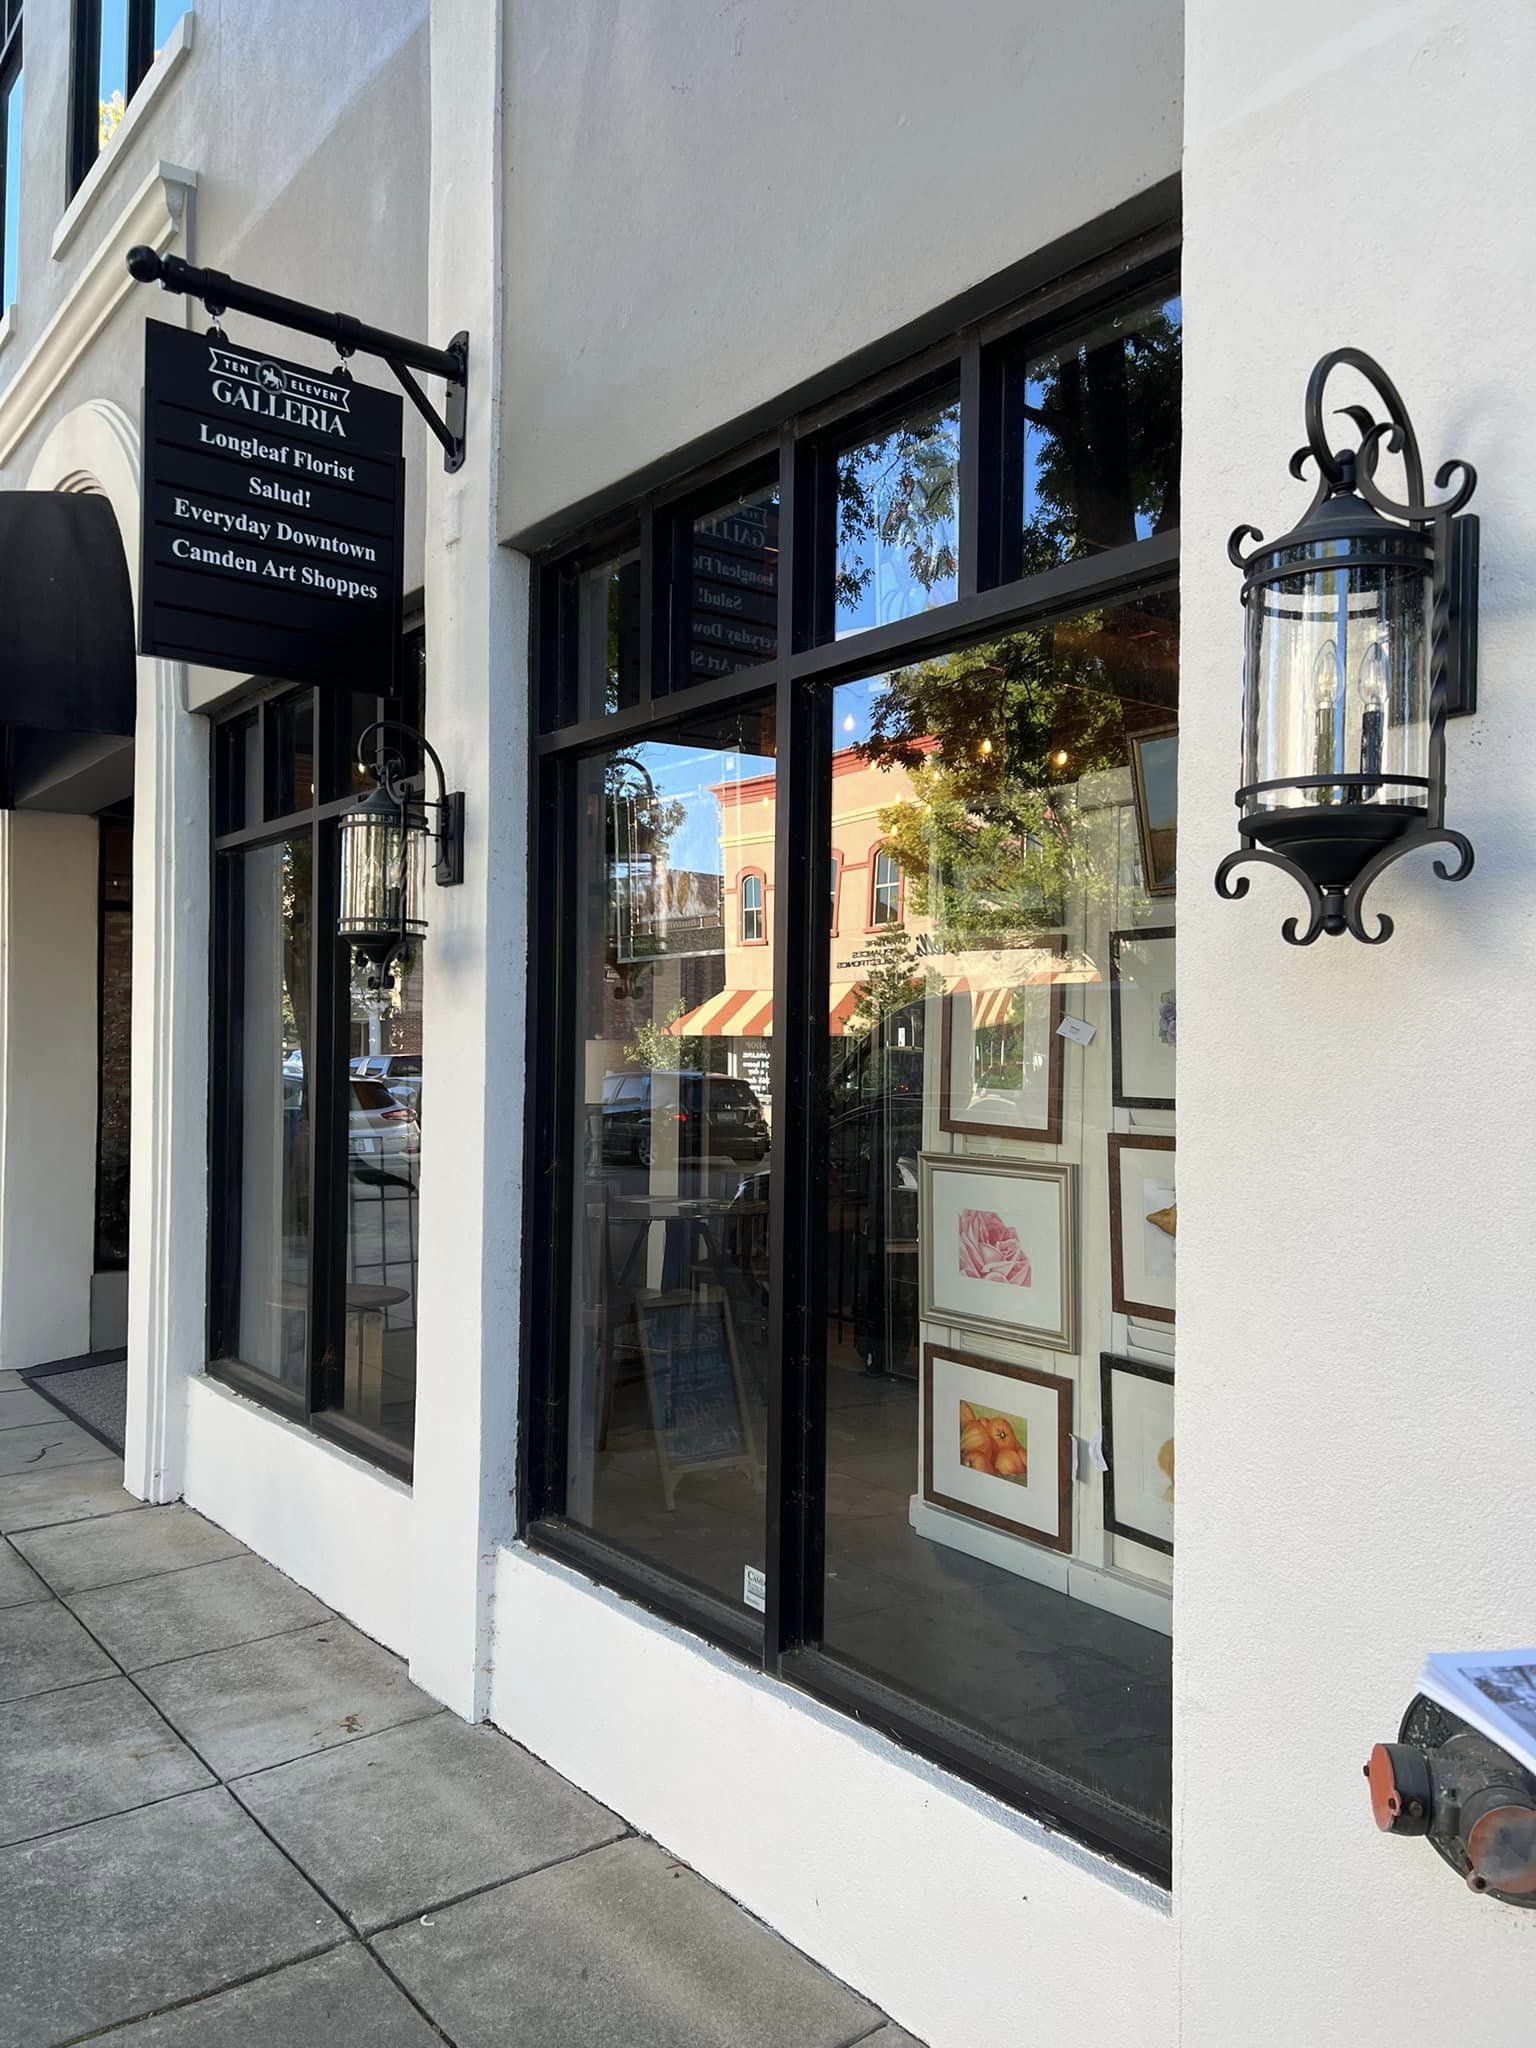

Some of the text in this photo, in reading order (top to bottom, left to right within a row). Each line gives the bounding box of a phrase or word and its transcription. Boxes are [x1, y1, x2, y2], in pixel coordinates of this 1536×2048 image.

[211, 379, 347, 438] GALLERIA
[223, 358, 338, 402] TEN ELEVEN
[200, 423, 356, 482] Longleaf Florist
[249, 476, 312, 508] Salud!
[174, 497, 377, 562] Everyday Downtown
[171, 538, 378, 599] Camden Art Shoppes
